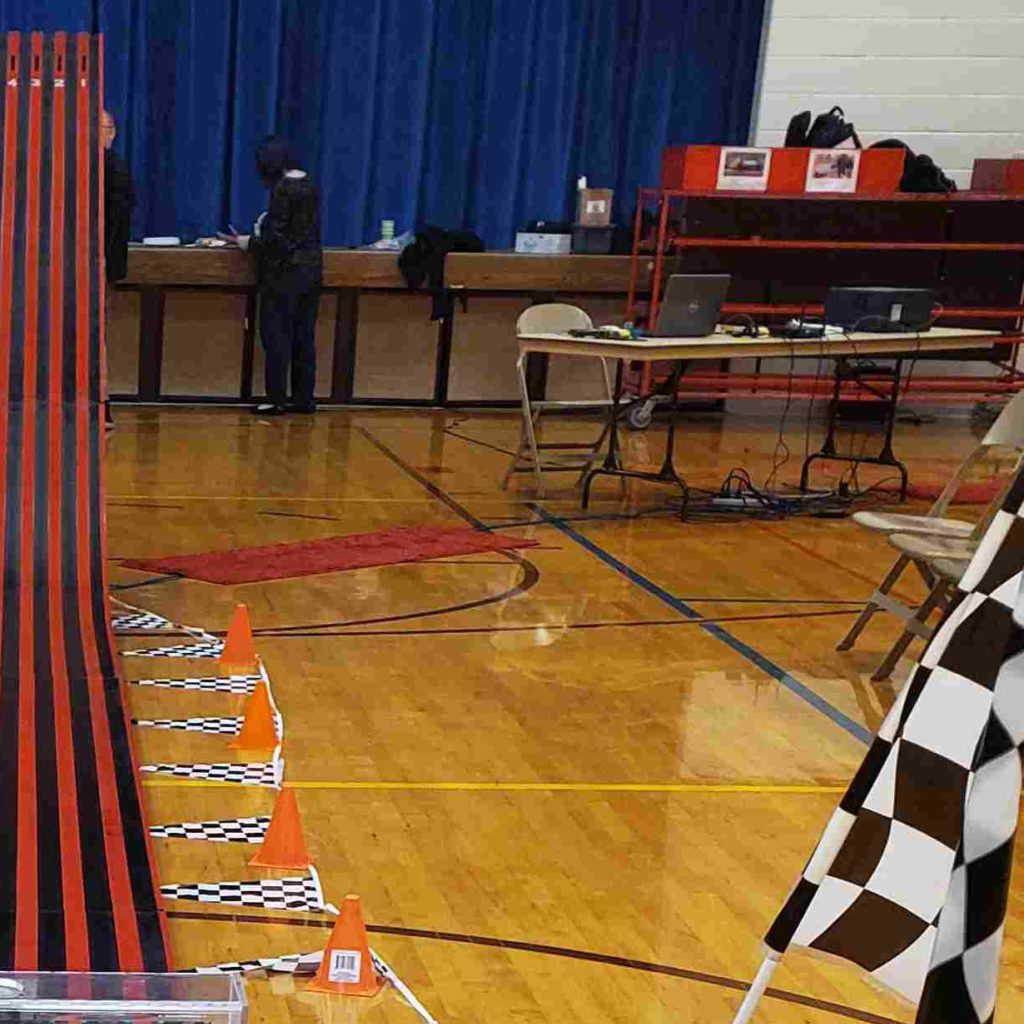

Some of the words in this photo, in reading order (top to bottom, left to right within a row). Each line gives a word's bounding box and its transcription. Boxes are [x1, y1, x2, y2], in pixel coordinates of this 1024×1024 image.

[7, 78, 18, 87] 4
[31, 78, 42, 87] 3
[54, 78, 66, 87] 2
